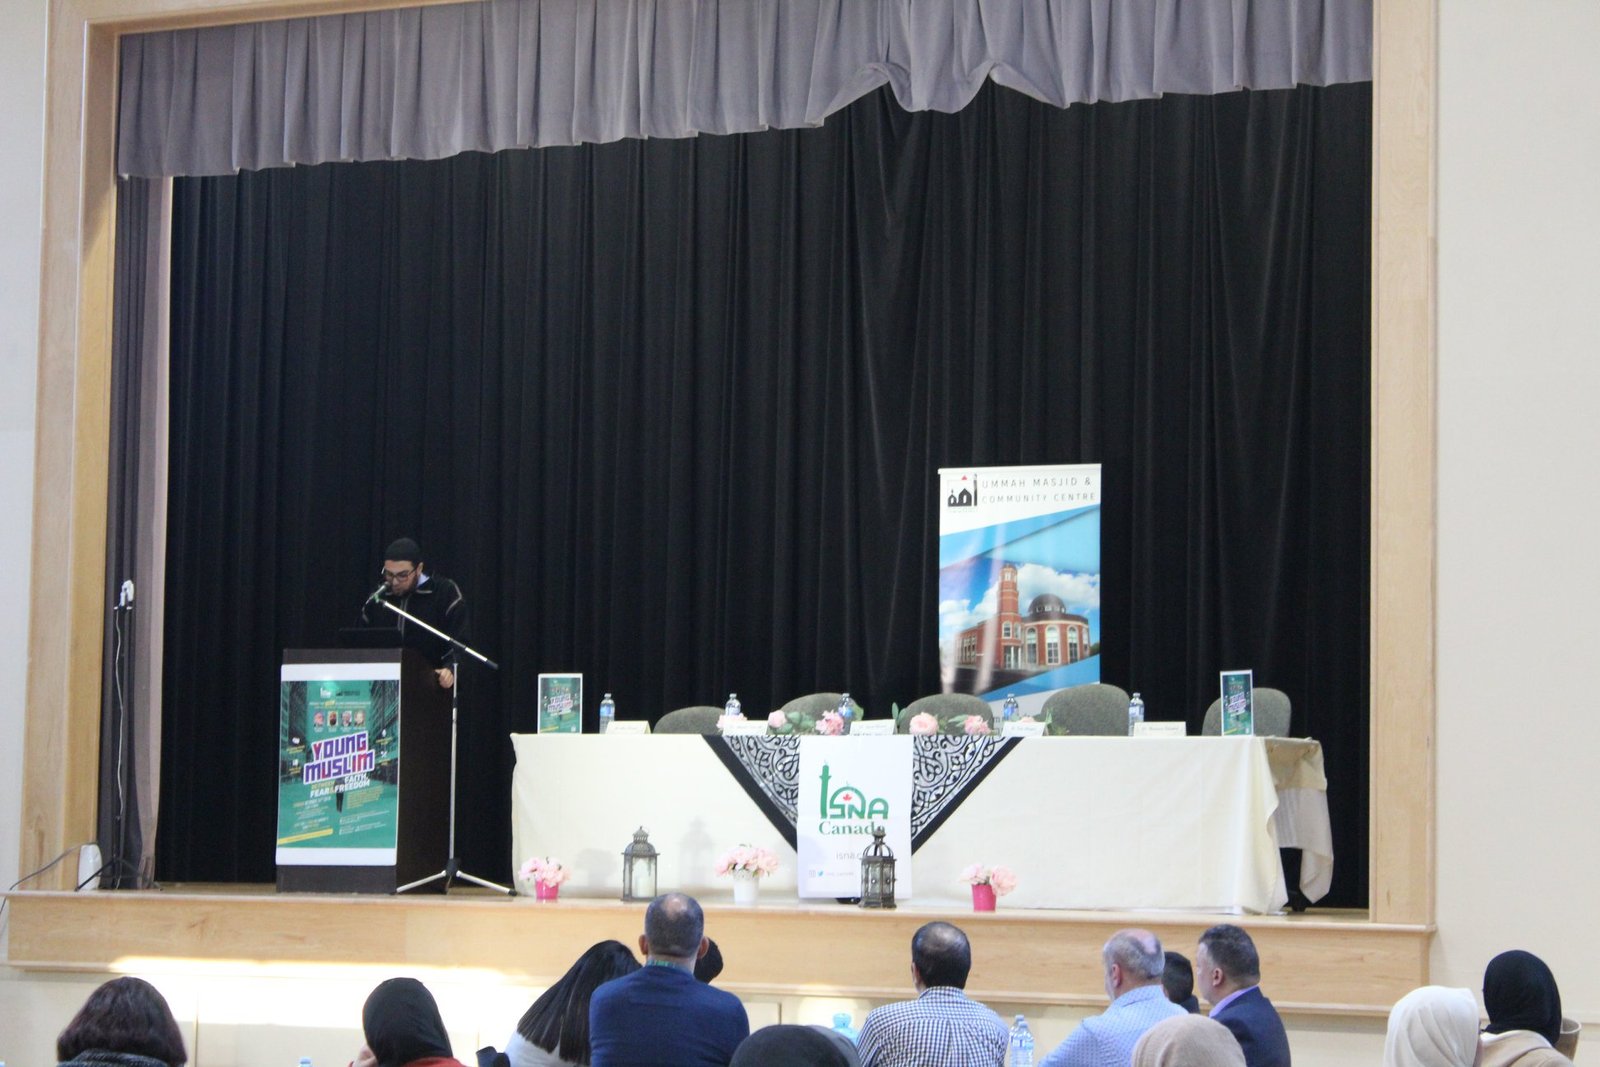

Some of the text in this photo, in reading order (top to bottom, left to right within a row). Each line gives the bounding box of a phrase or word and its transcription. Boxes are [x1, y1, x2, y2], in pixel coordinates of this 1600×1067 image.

[982, 476, 1092, 489] UMMAH MASJID &
[981, 492, 1096, 504] COMMUNITY CENTRE
[311, 731, 368, 761] YOUNG
[304, 750, 375, 784] MUSLIM
[334, 779, 371, 794] FREEDOM
[819, 762, 889, 820] ISNA
